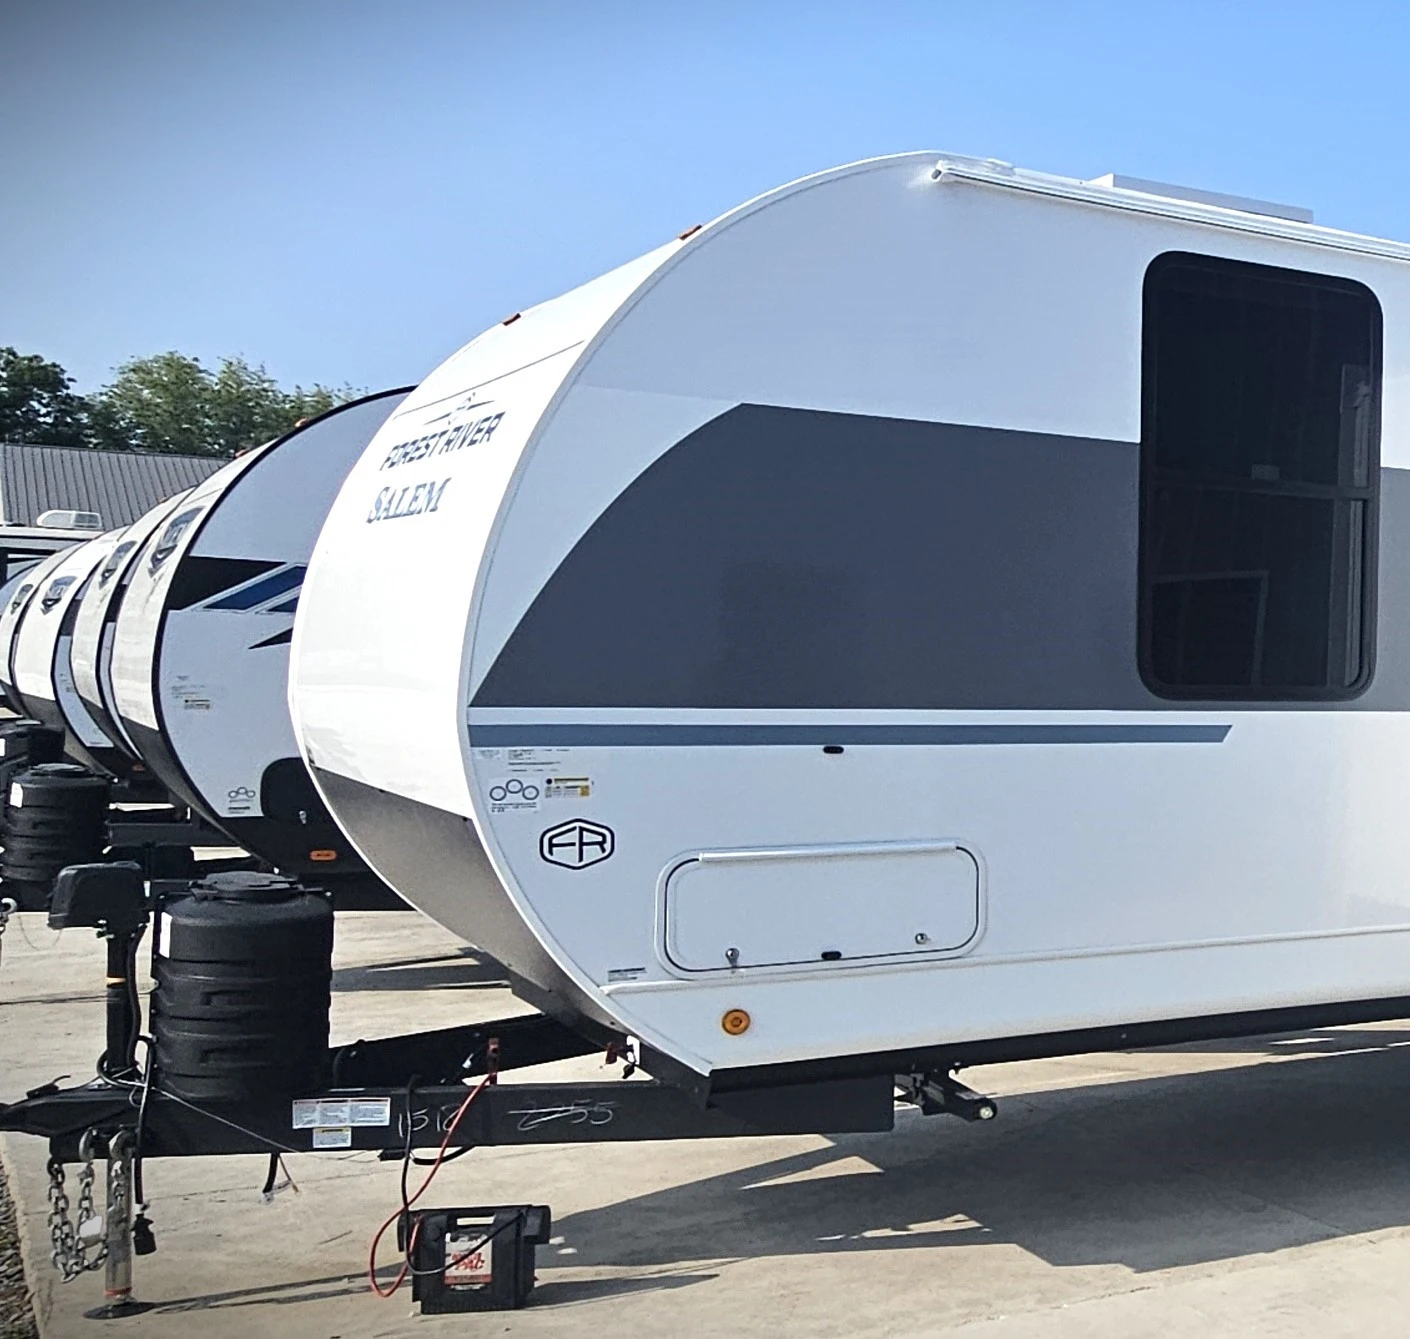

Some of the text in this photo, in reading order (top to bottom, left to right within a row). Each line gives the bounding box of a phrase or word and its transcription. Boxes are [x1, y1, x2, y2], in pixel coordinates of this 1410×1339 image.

[378, 411, 506, 471] FOREST RIVER
[366, 477, 452, 524] SALEM
[548, 825, 607, 863] FR
